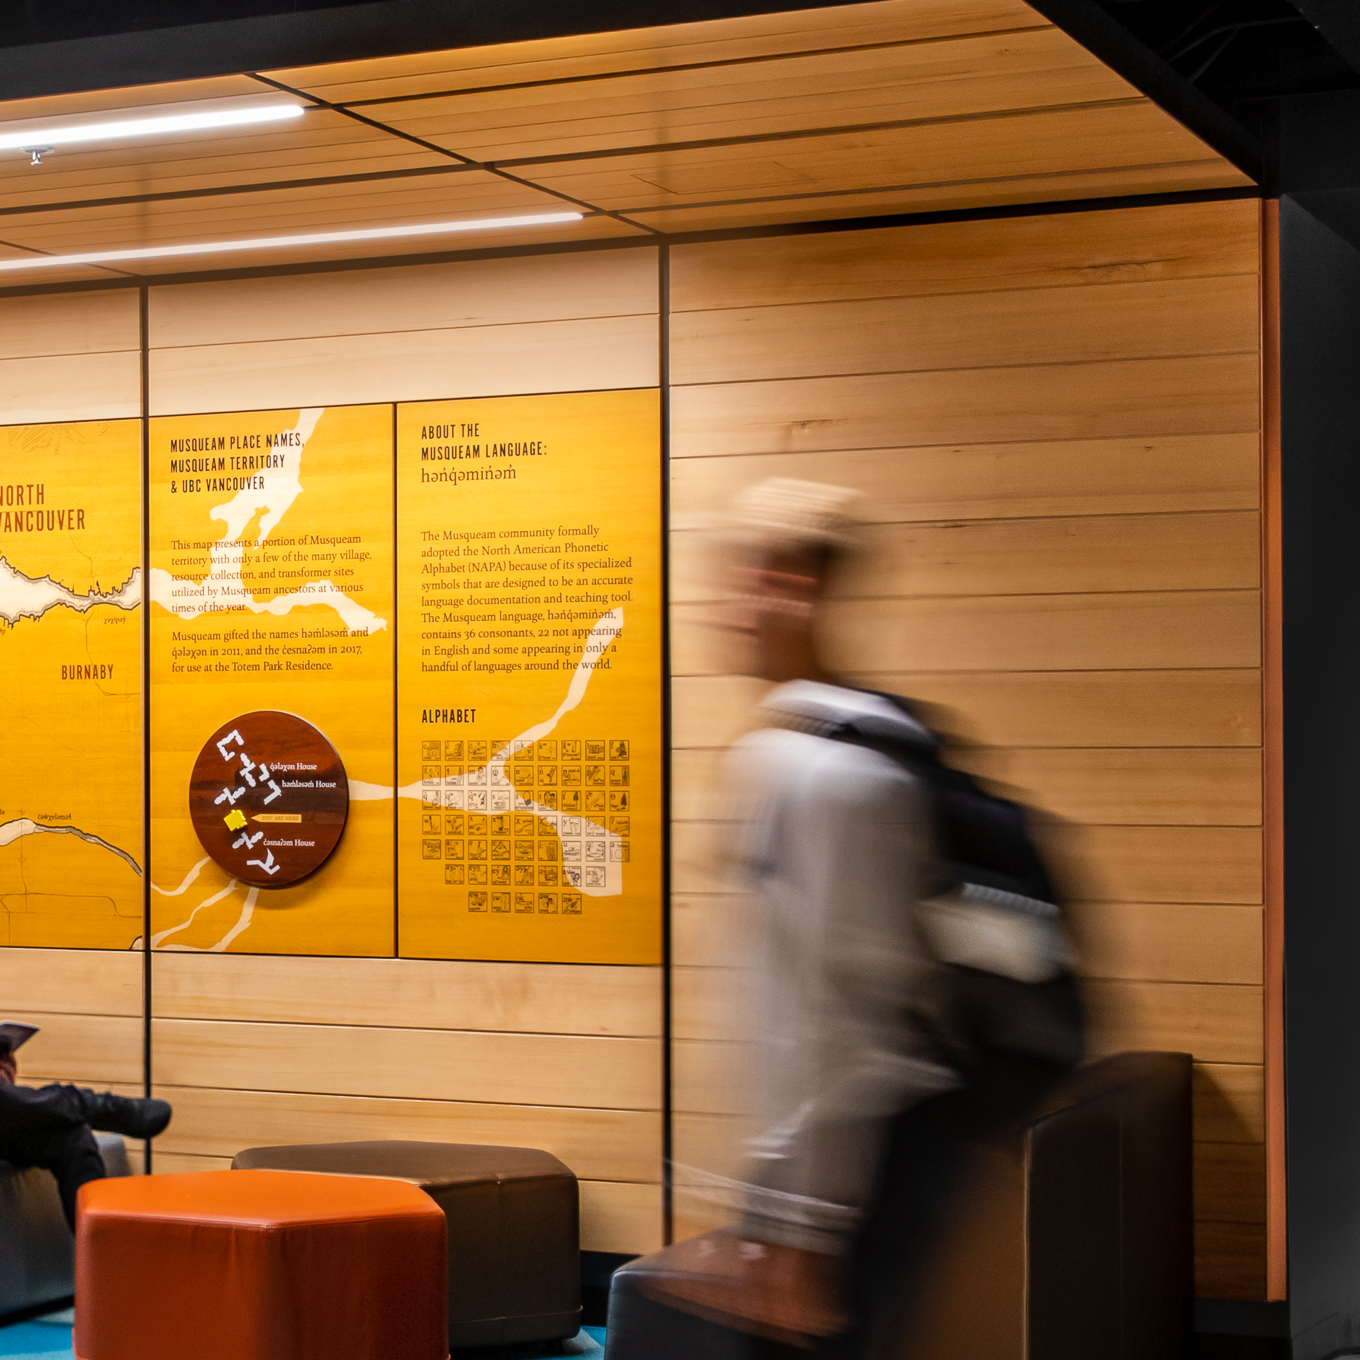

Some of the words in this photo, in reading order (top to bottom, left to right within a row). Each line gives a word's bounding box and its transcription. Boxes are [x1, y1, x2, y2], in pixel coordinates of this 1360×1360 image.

[421, 424, 455, 439] ABOUT
[461, 423, 480, 437] THE
[170, 436, 225, 453] MUSQUEAM
[230, 435, 261, 450] PLACE
[266, 433, 305, 448] NAMES,
[421, 445, 480, 461] MUSQUEAM
[486, 441, 547, 457] LANGUAGE:
[170, 457, 225, 473] MUSQUEAM
[230, 455, 285, 470] TERRITORY
[171, 481, 178, 493] &
[182, 480, 201, 492] UBC
[206, 477, 264, 491] VANCOUVER
[421, 531, 439, 541] The
[443, 531, 496, 542] Musqueam
[499, 528, 555, 539] community
[558, 525, 600, 538] formally
[171, 540, 190, 550] This
[193, 542, 212, 551] map
[215, 540, 251, 550] presents
[262, 537, 295, 549] portion
[298, 535, 307, 545] of
[310, 535, 361, 549] Musqueam
[421, 563, 465, 576] Alphabet
[468, 561, 506, 573] (NAPA)
[509, 560, 547, 571] because
[550, 559, 561, 570] of
[563, 560, 575, 569] its
[577, 557, 632, 572] specialized
[61, 664, 114, 680] BURNABY
[172, 662, 184, 672] for
[187, 664, 201, 672] use
[204, 663, 212, 672] at
[215, 662, 229, 672] the
[231, 662, 260, 672] Totem
[263, 661, 283, 671] Park
[285, 661, 333, 671] Residence.
[422, 661, 458, 672] handful
[461, 661, 472, 671] of
[474, 661, 522, 674] languages
[524, 660, 559, 670] around
[562, 659, 578, 670] the
[582, 659, 612, 670] world.
[422, 709, 477, 723] ALPHABET
